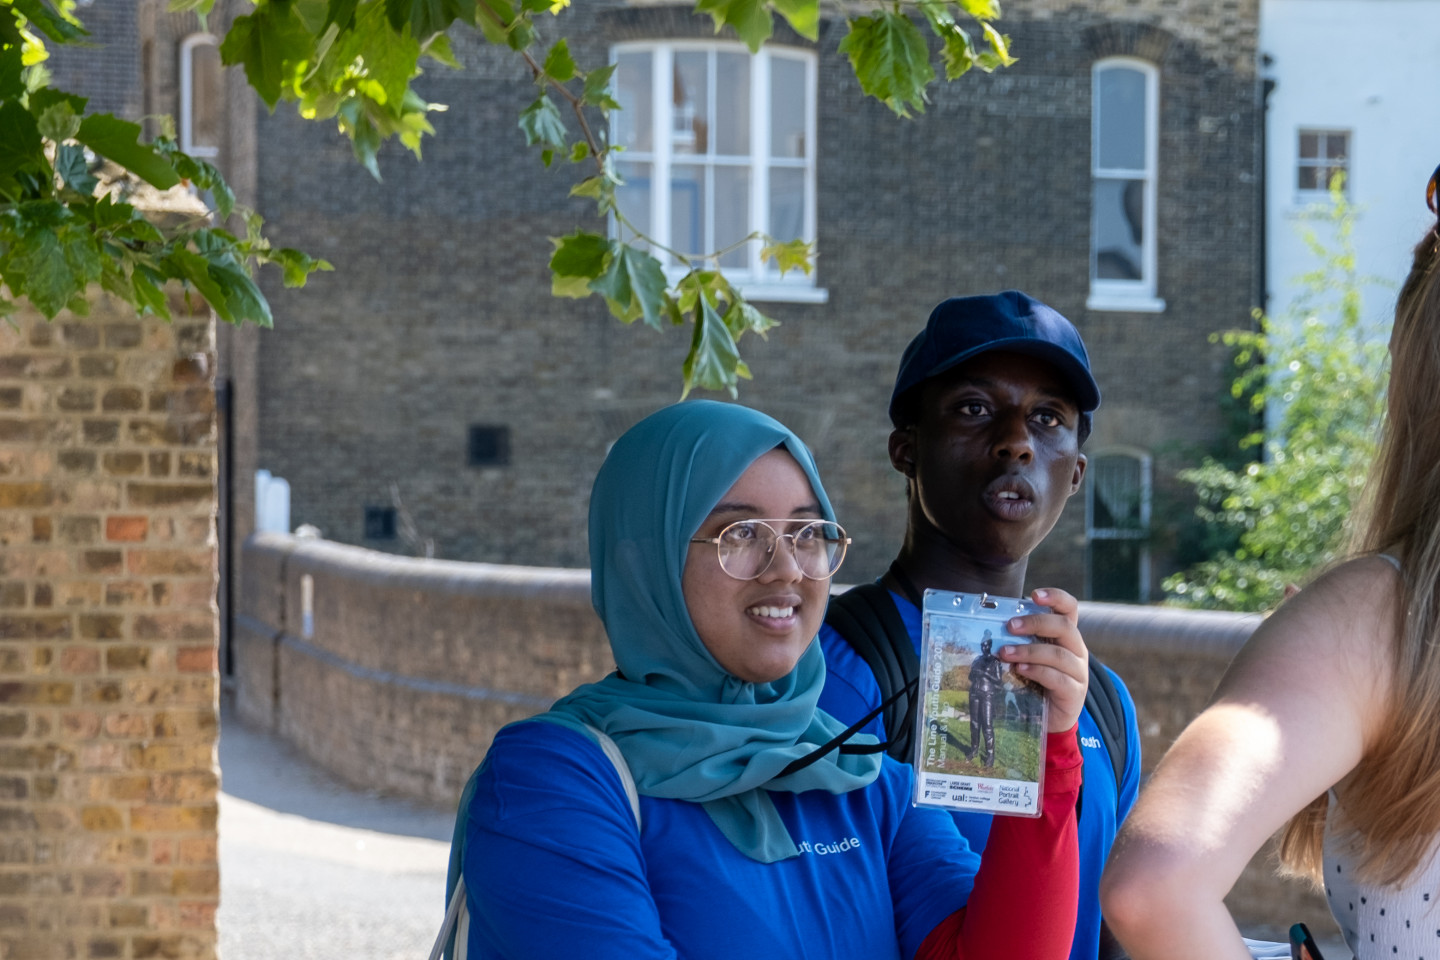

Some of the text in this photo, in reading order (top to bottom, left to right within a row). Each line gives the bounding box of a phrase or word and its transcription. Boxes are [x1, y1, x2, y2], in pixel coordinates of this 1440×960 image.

[931, 662, 942, 692] Guide
[930, 693, 940, 722] Youth
[928, 724, 938, 746] Line
[926, 748, 936, 767] The
[937, 733, 947, 769] Manual
[998, 798, 1019, 807] Gallery
[814, 837, 861, 855] Guide
